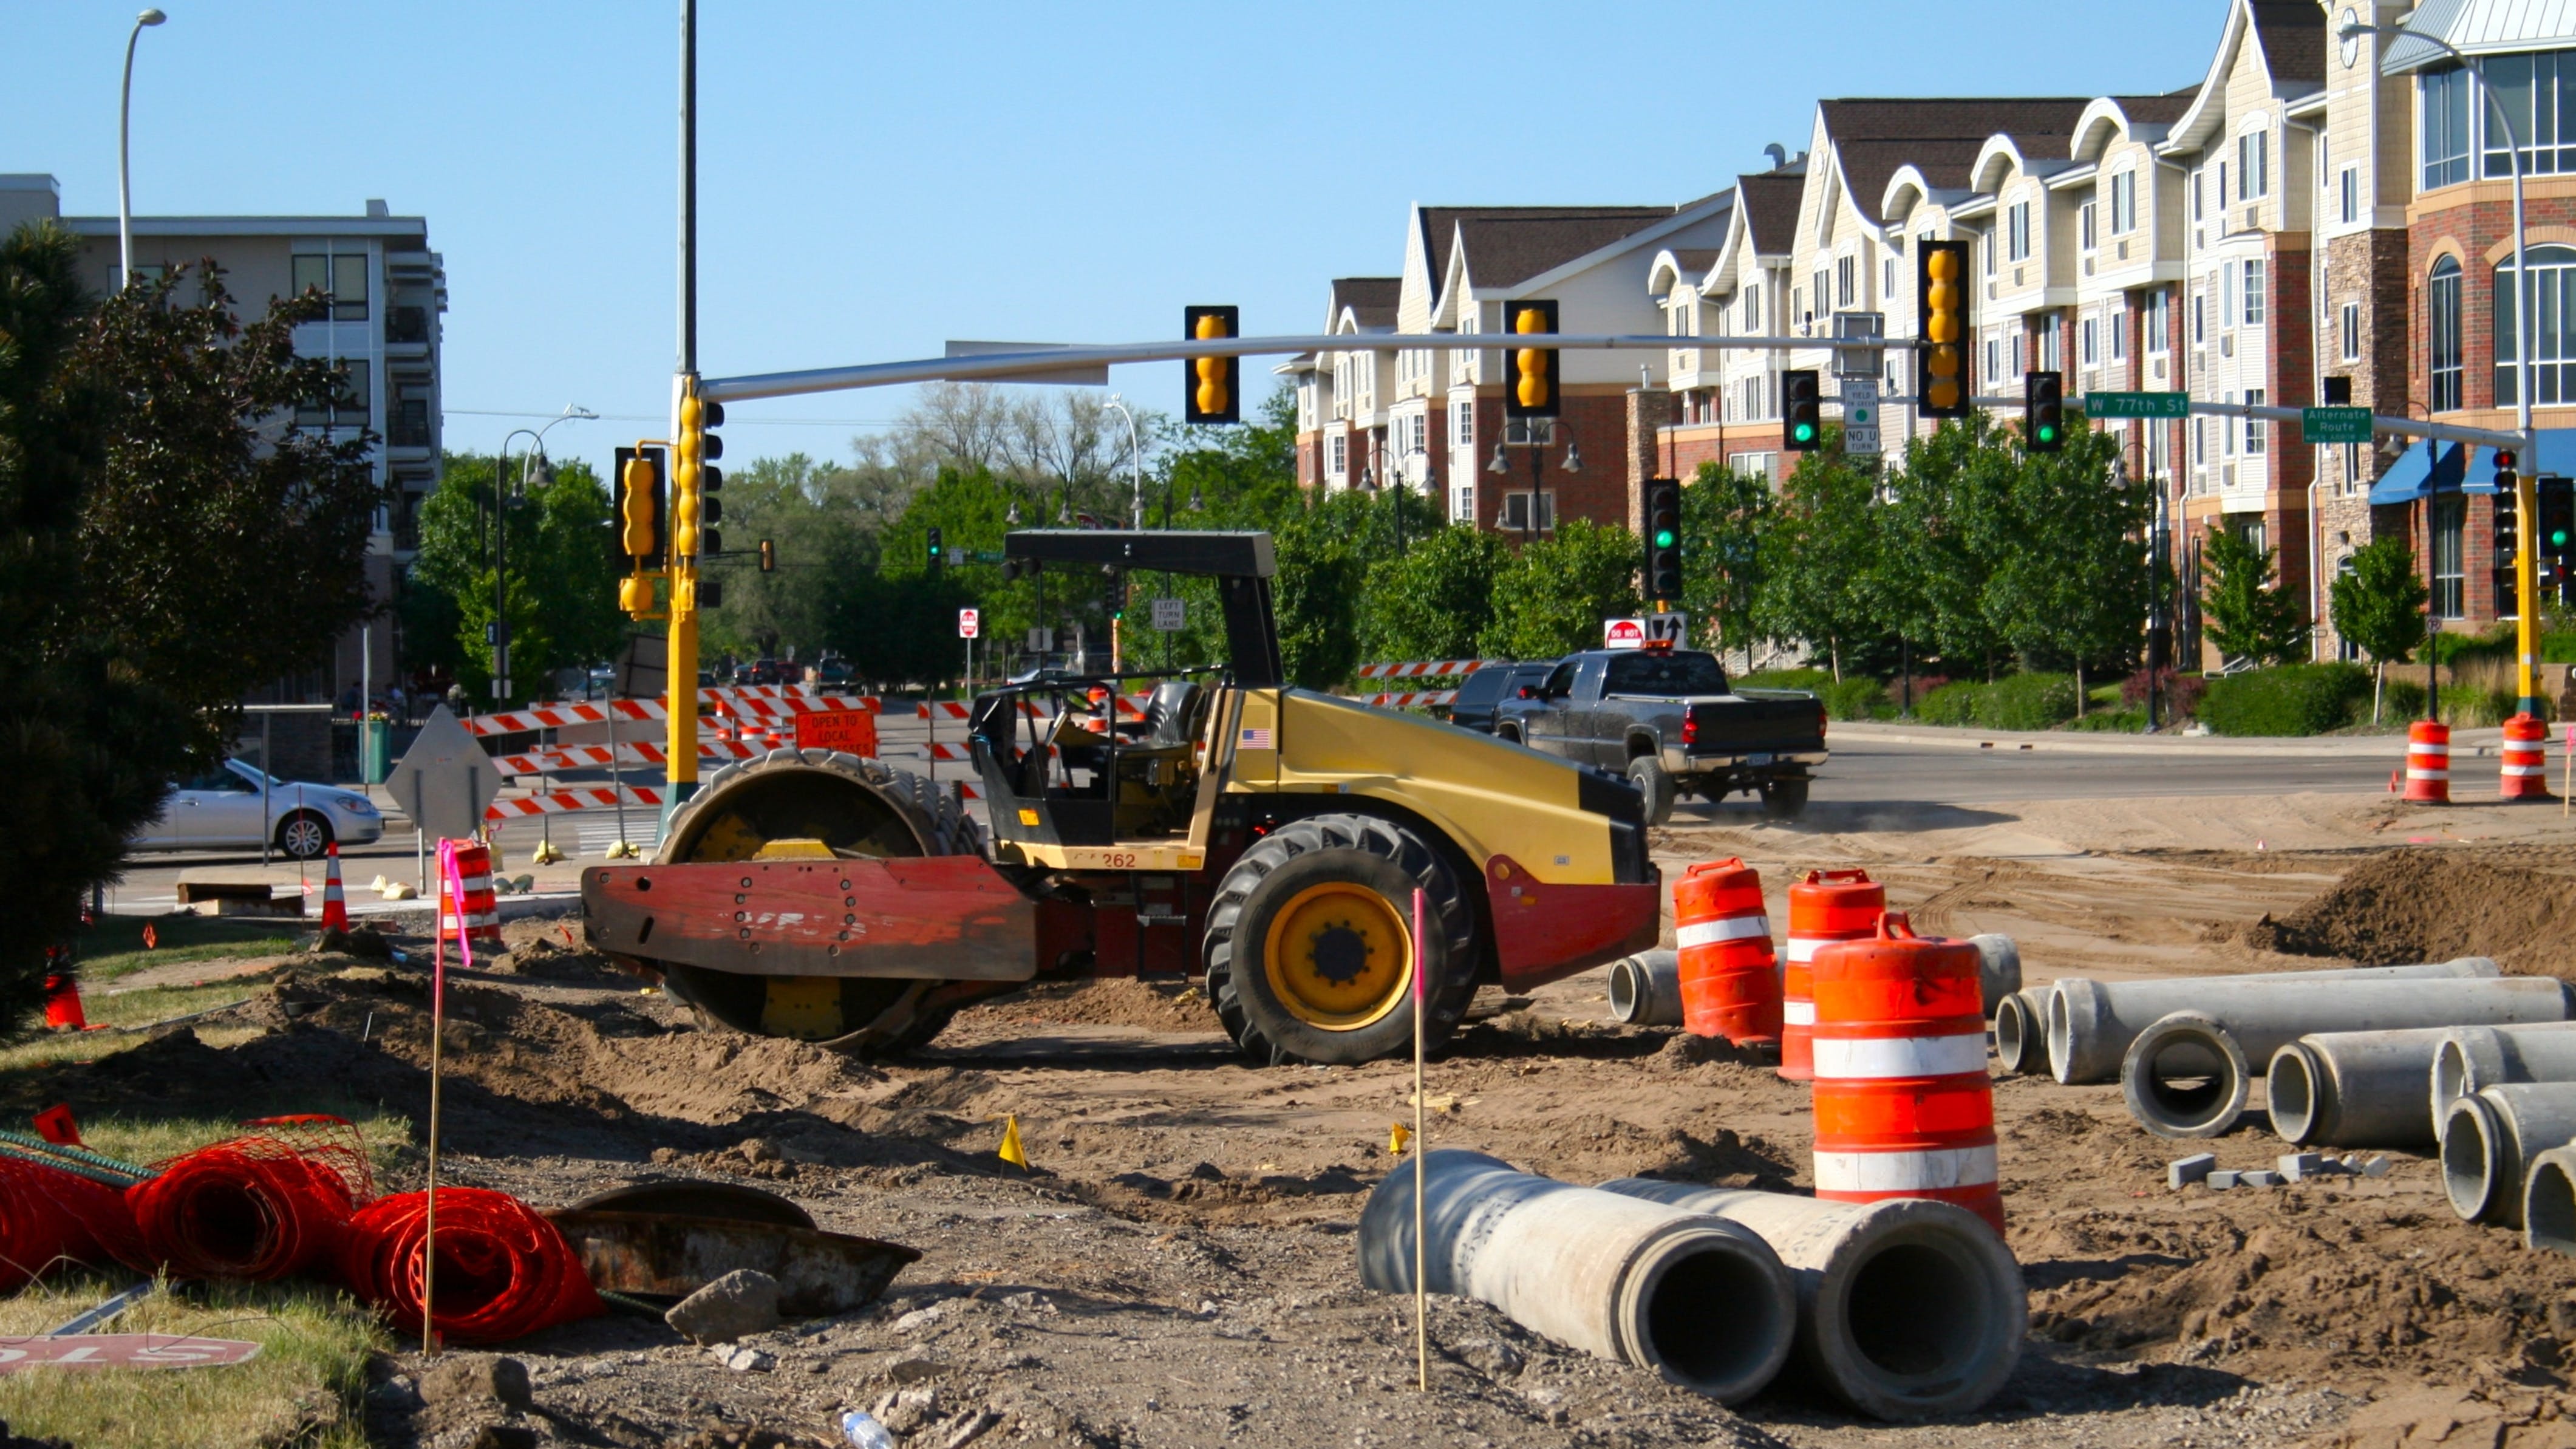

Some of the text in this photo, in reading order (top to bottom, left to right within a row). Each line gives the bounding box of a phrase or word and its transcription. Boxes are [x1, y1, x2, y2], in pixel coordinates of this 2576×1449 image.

[2090, 398, 2185, 412] W 77th St
[2308, 410, 2366, 419] Alternate
[2320, 421, 2355, 432] Route
[1848, 430, 1876, 442] NO U
[1157, 619, 1180, 628] LANE
[1610, 629, 1638, 638] DO NOT
[811, 715, 857, 728] OPEN TO
[818, 730, 850, 742] LOCAL
[828, 743, 870, 754] NESSES
[1102, 853, 1136, 868] 262
